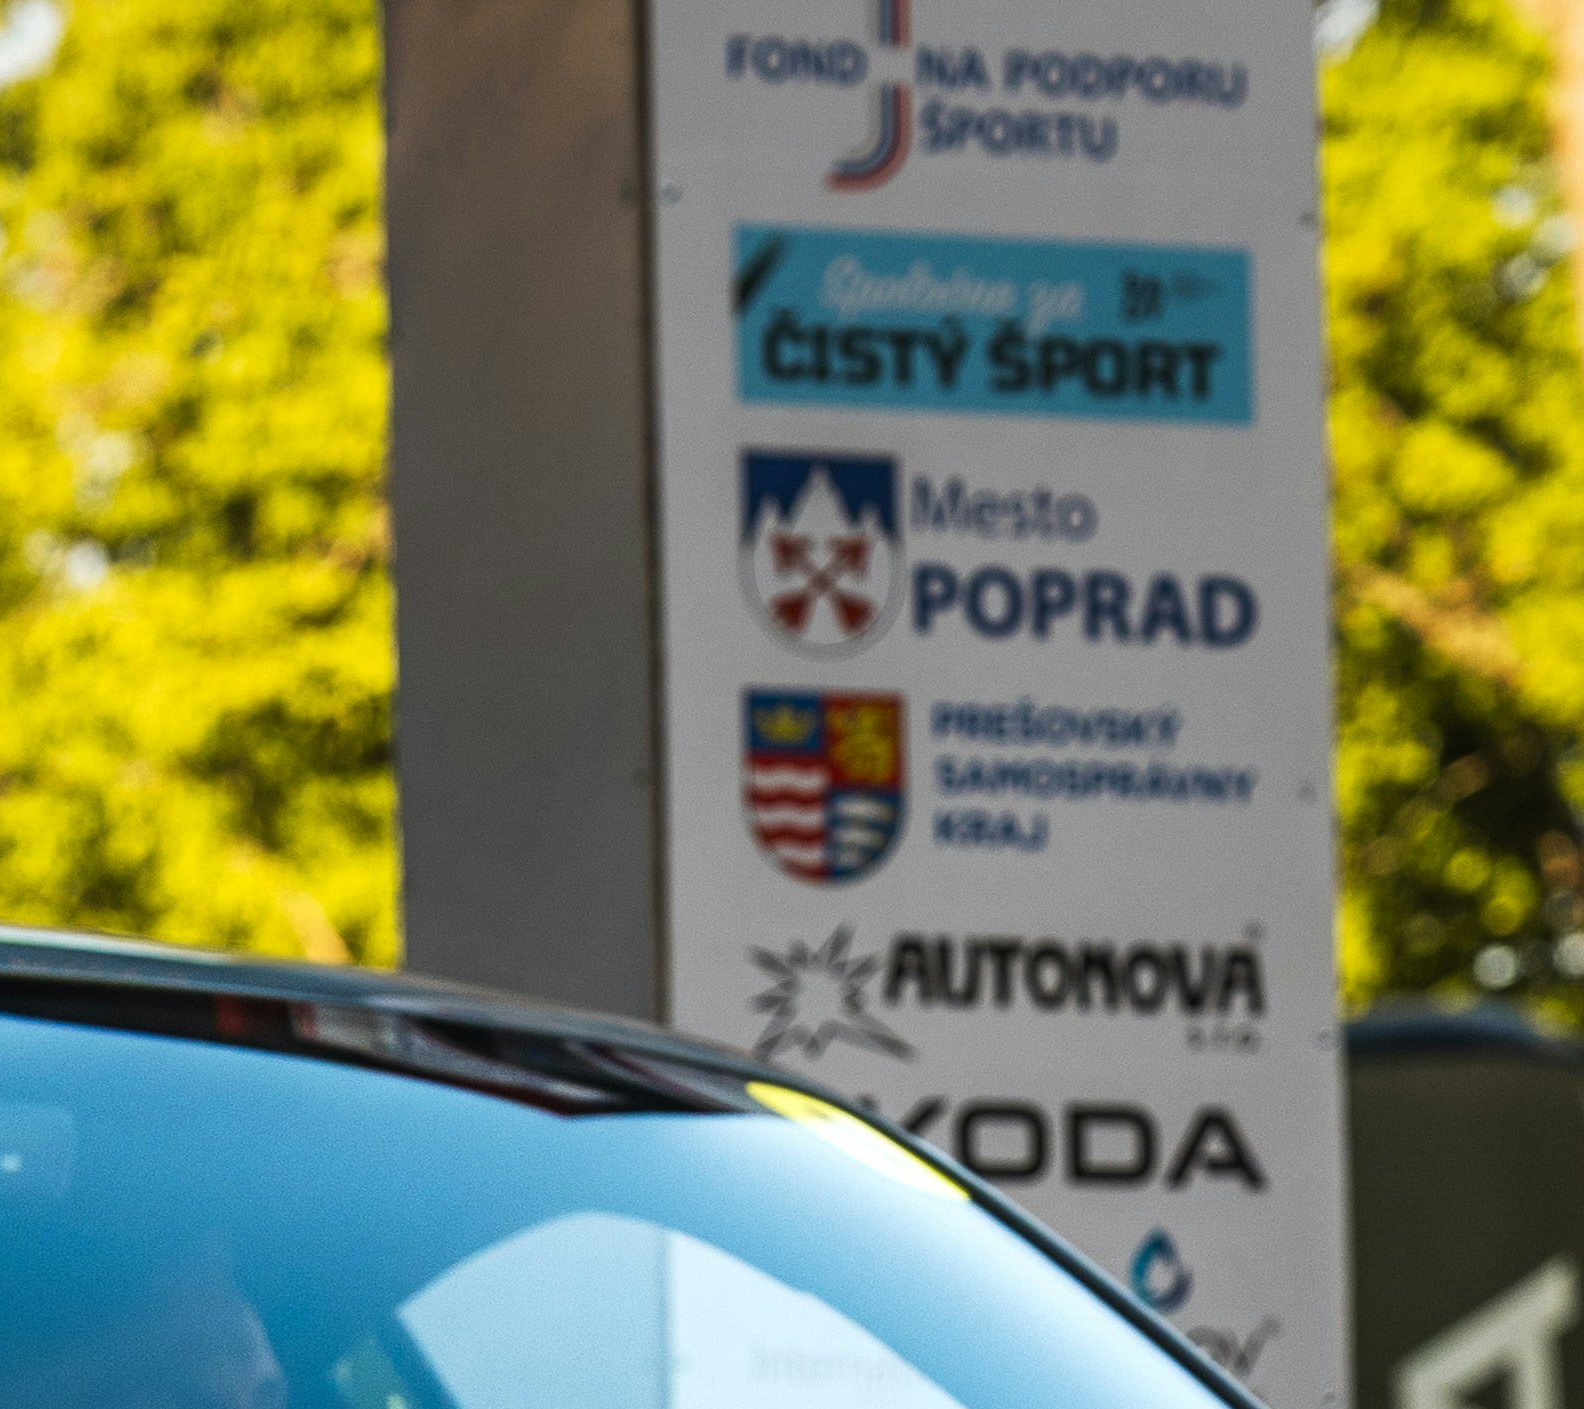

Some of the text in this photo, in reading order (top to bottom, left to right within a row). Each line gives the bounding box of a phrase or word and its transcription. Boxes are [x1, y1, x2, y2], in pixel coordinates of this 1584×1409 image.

[724, 33, 1249, 109] FOND NA PODPORU
[920, 96, 1119, 165] ŠPORTU
[760, 306, 1222, 399] ČISTÝ ŠPORT
[911, 472, 1098, 544] Mesto
[911, 558, 1260, 650] POPRAD
[930, 695, 1182, 748] PREŠOVSKÝ
[932, 808, 1051, 854] KRAJ
[882, 930, 1267, 1020] AUTONOVA
